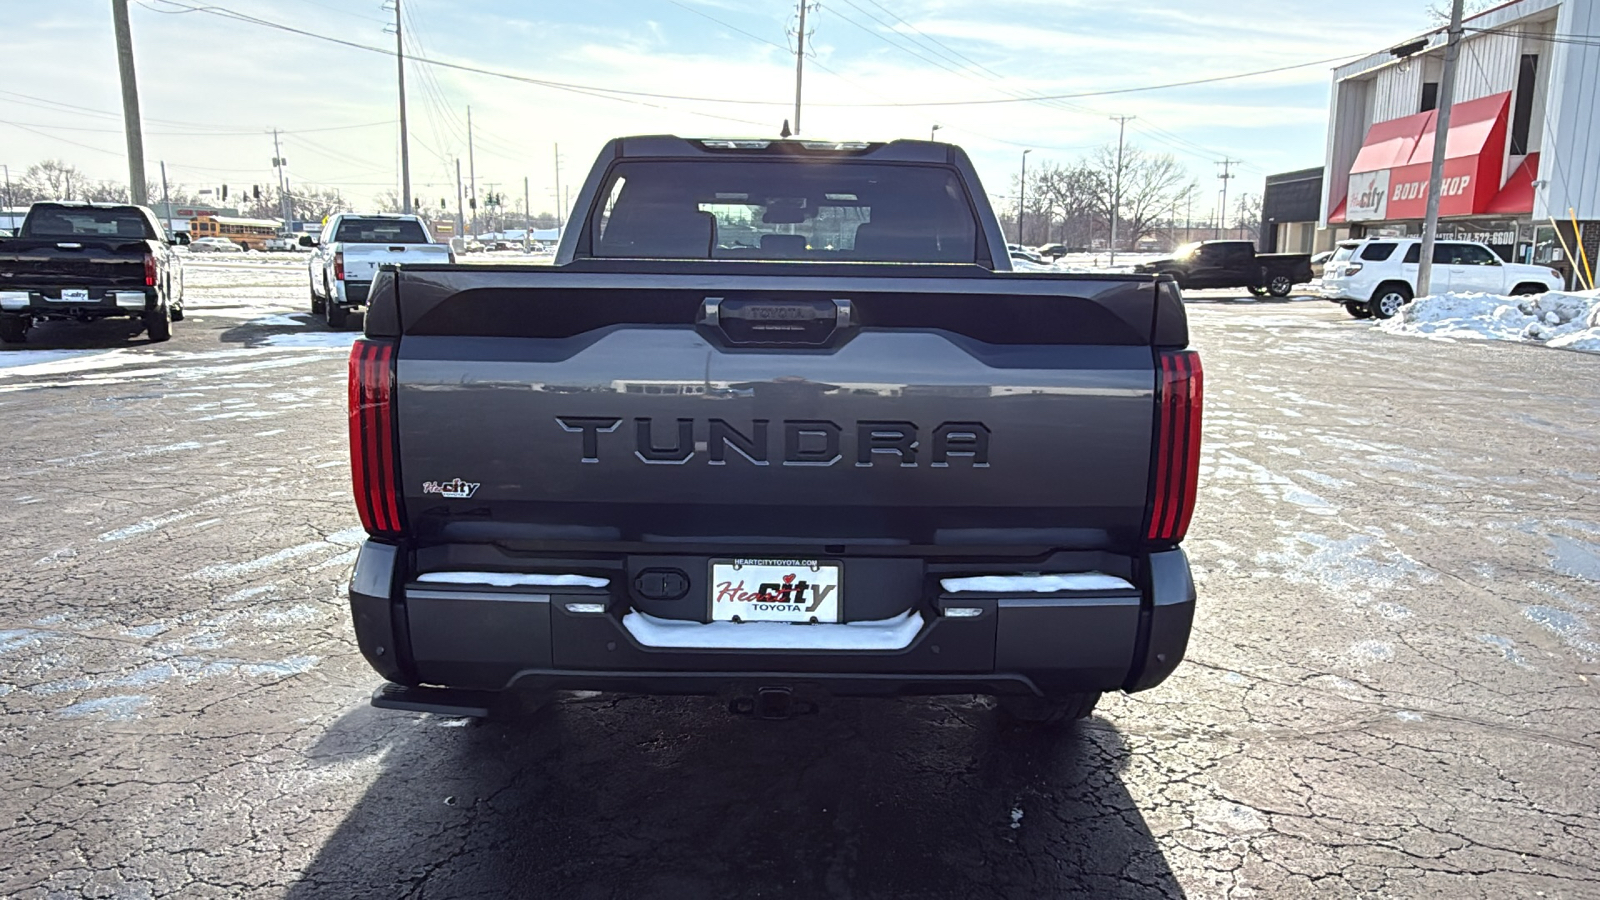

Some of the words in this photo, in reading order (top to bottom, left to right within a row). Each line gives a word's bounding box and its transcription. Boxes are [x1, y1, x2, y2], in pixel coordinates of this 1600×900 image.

[1392, 180, 1429, 201] BODY
[1439, 174, 1471, 197] HOP
[1457, 231, 1515, 246] 574-522-6600
[751, 307, 805, 319] TOYOTA
[555, 415, 991, 468] TUNDRA
[734, 558, 818, 566] HEARTCITYTOYOTA.COM
[716, 580, 801, 603] Heart
[757, 575, 837, 612] city
[752, 603, 801, 612] TOYOTA
